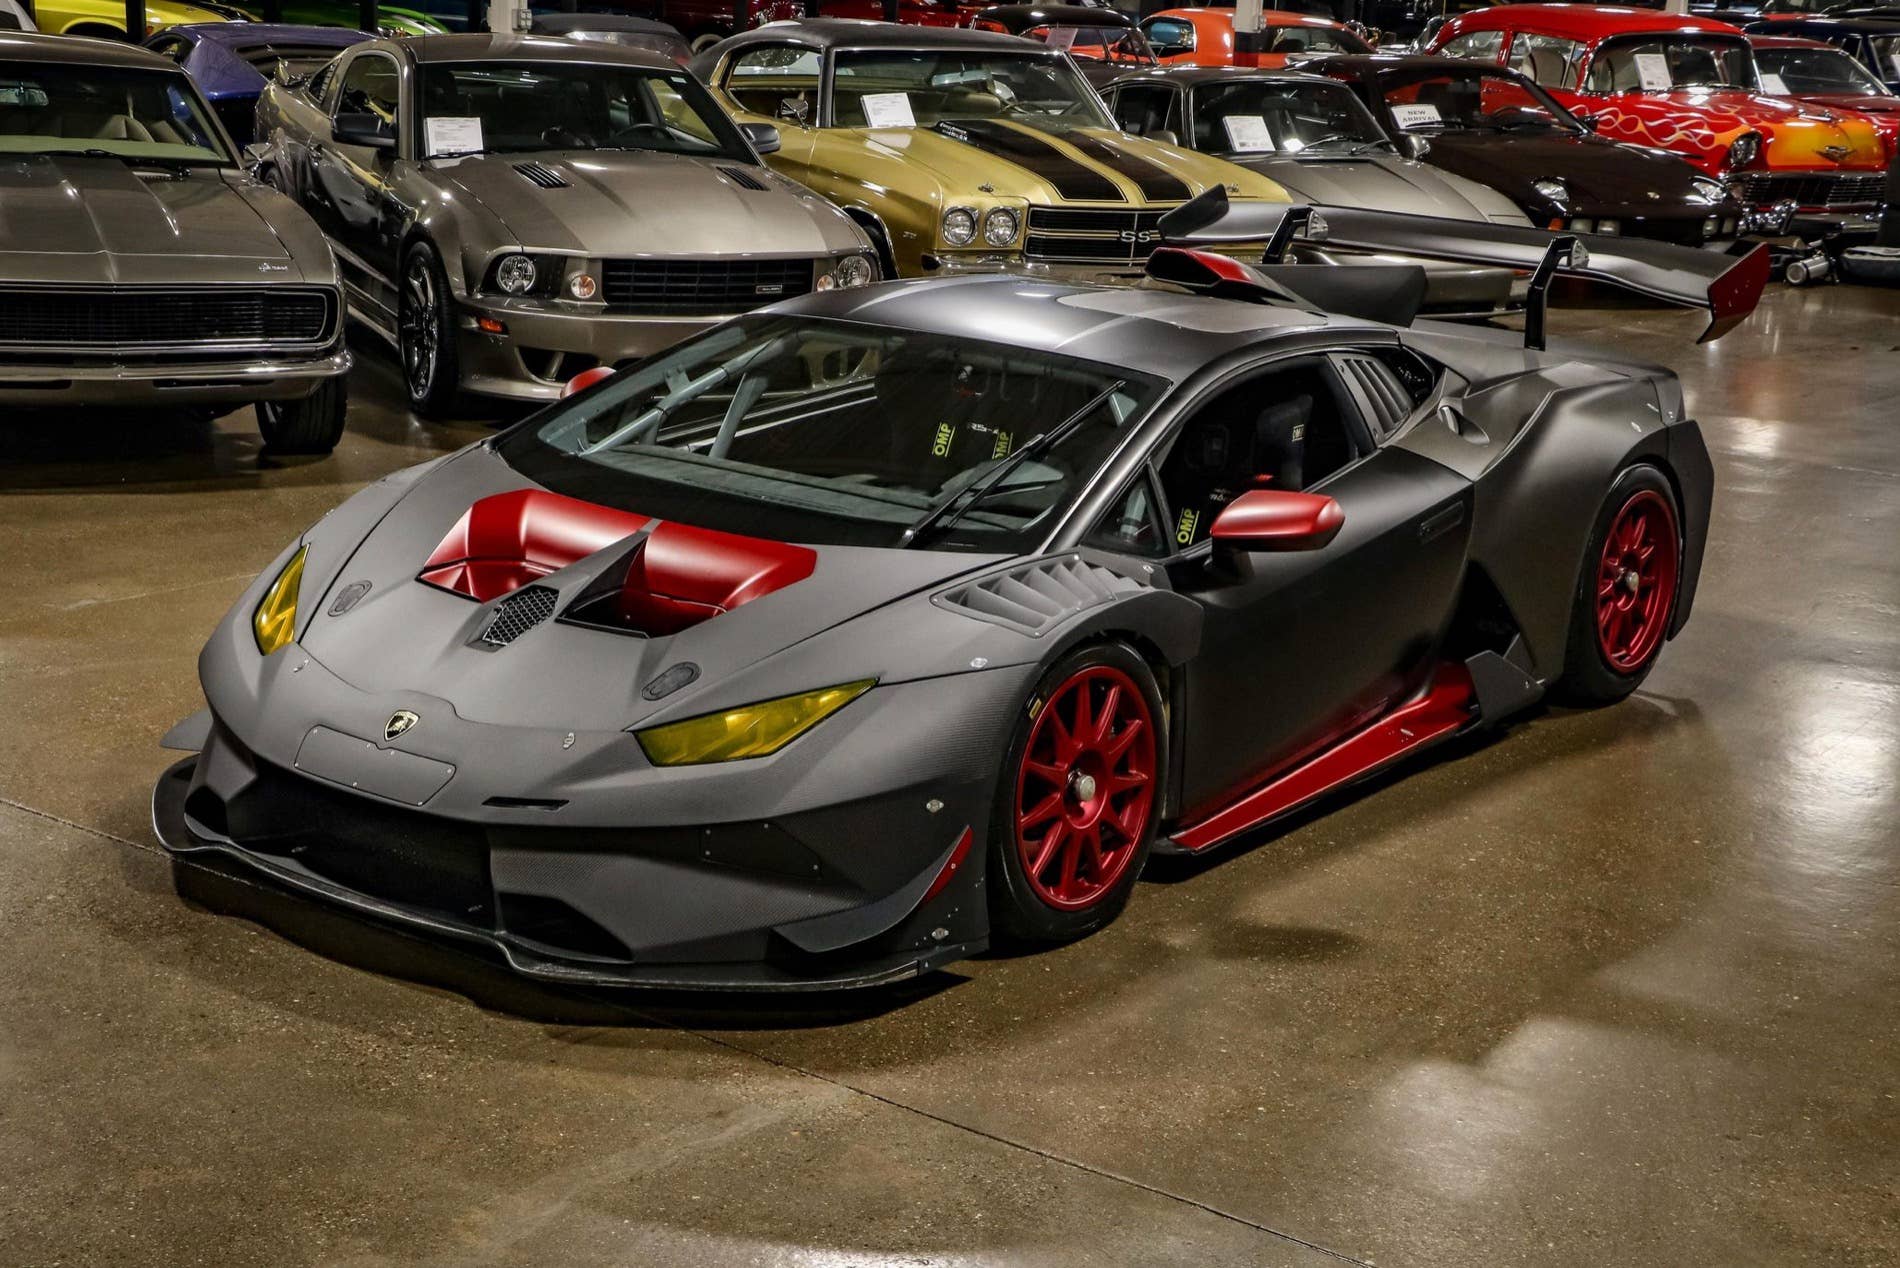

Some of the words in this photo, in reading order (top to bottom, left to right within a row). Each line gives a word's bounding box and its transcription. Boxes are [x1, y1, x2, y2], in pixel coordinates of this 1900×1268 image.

[1121, 231, 1150, 242] SS
[934, 423, 951, 456] OMP
[1177, 508, 1195, 543] OMP
